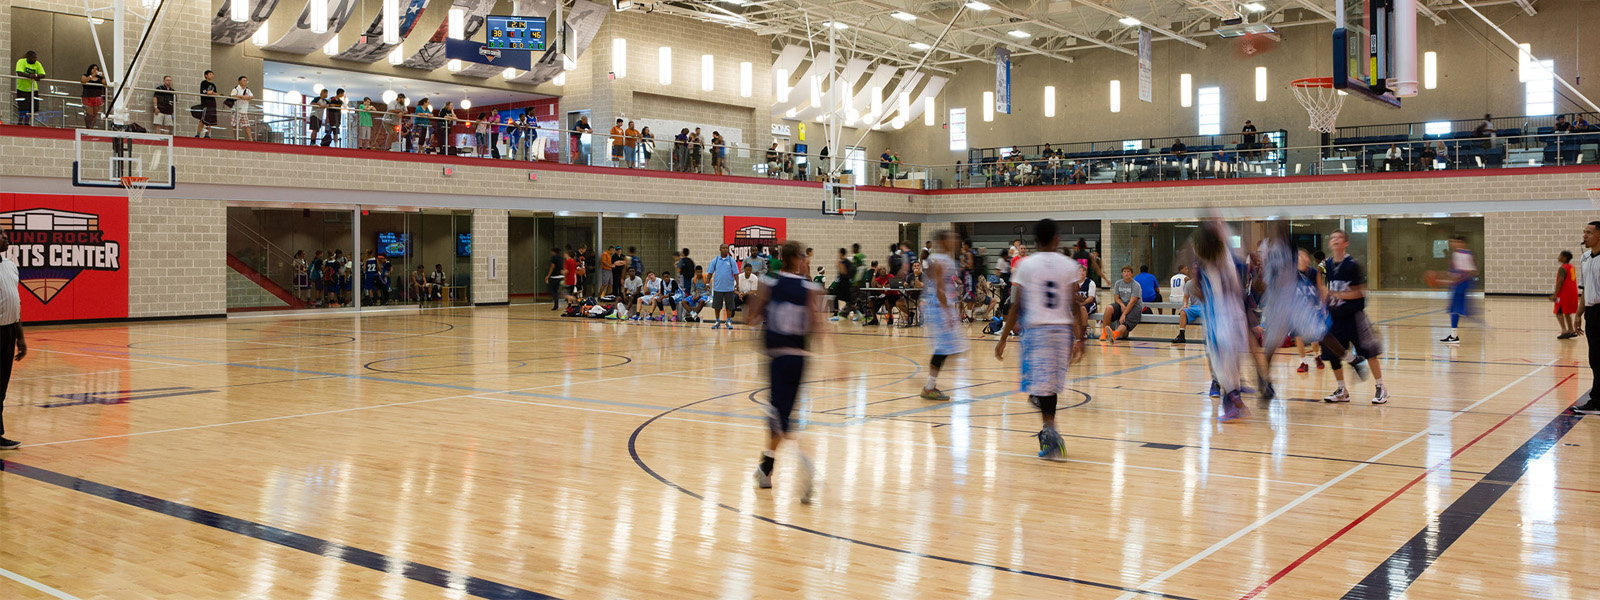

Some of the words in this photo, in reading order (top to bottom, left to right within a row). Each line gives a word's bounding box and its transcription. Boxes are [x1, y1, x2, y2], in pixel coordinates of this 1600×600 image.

[53, 232, 100, 243] ROCK
[49, 242, 119, 268] CENTER
[1173, 278, 1181, 287] 10
